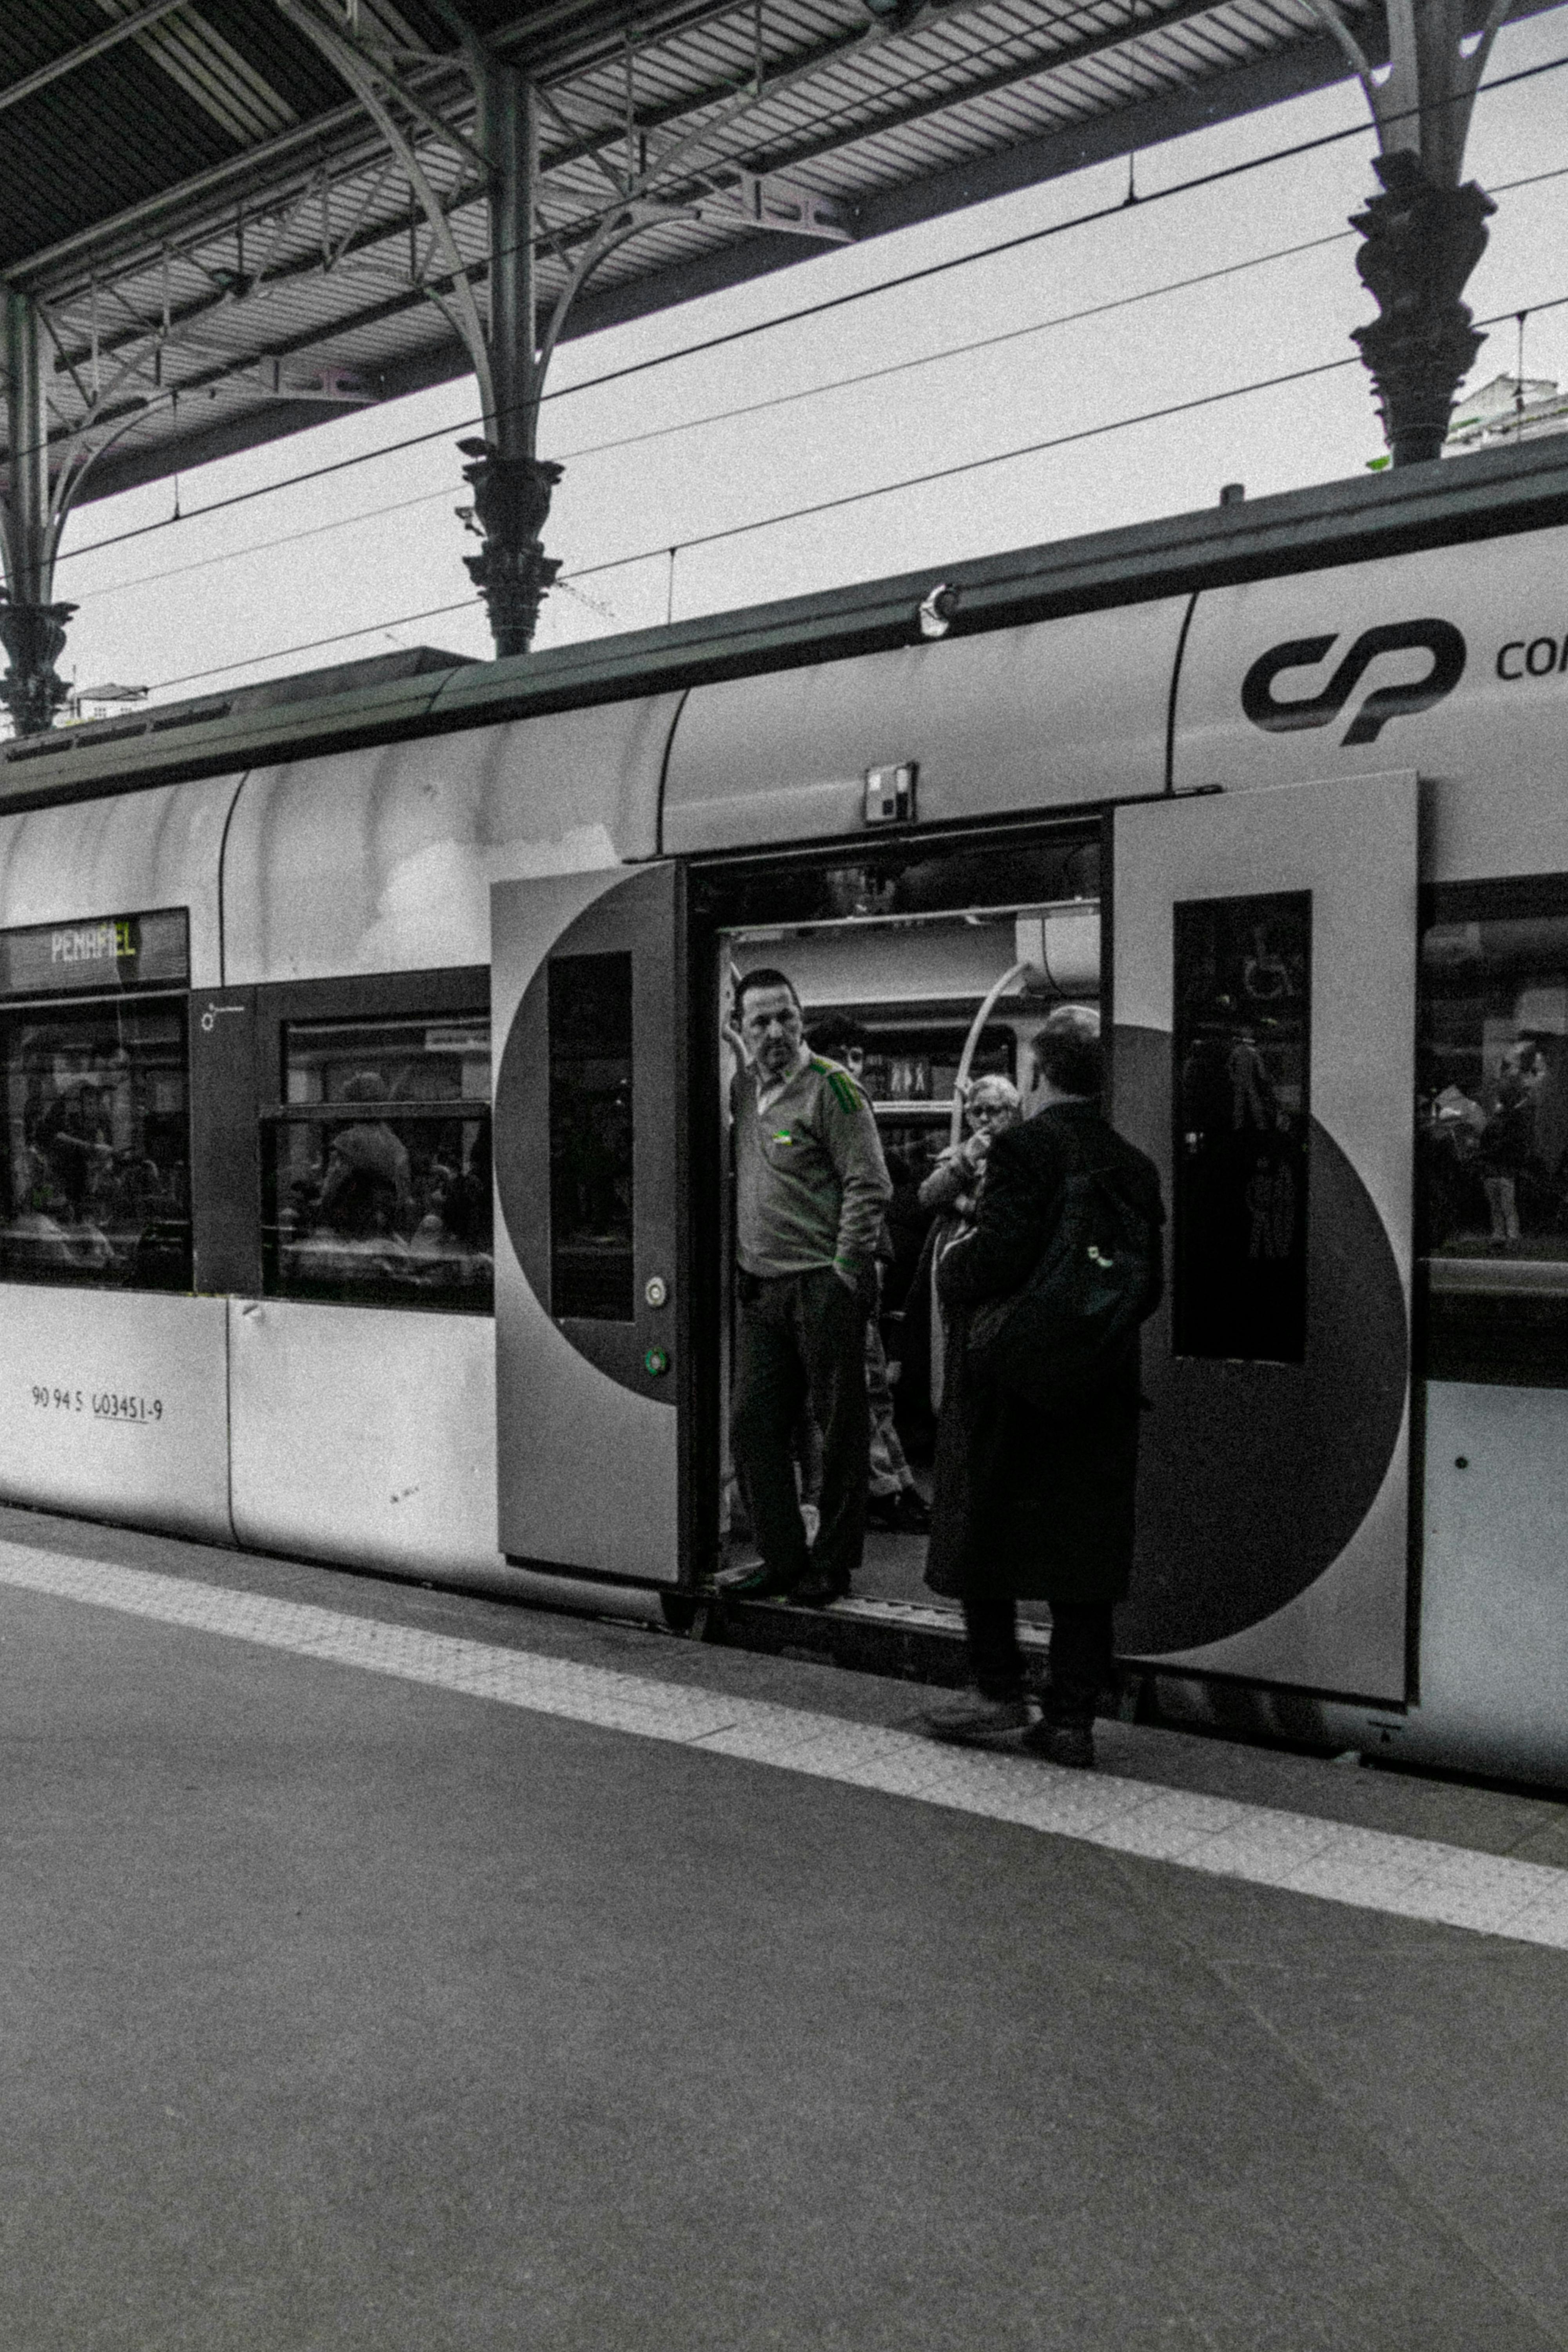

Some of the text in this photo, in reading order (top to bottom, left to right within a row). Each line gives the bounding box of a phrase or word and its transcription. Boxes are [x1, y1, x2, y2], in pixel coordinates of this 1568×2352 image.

[1496, 633, 1568, 681] co
[32, 1385, 49, 1407] 90
[53, 1388, 70, 1410] 94
[75, 1390, 83, 1412] 5
